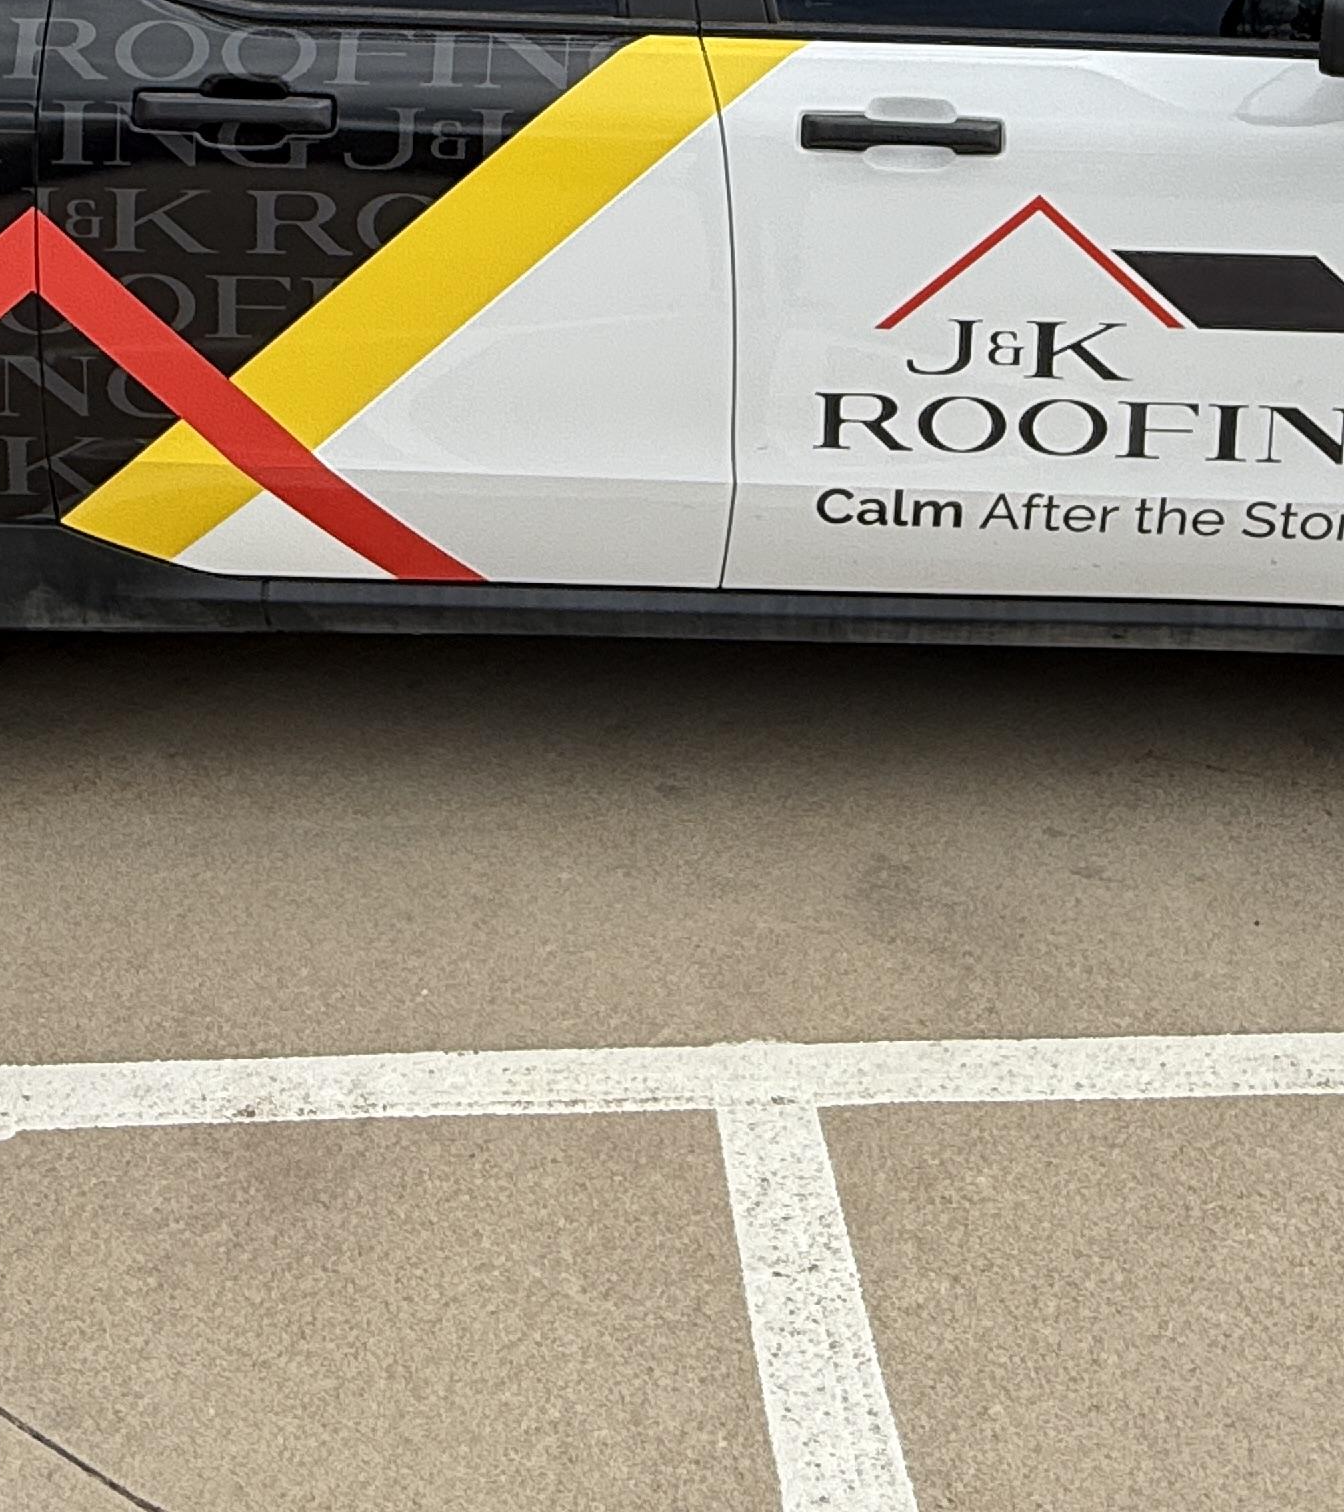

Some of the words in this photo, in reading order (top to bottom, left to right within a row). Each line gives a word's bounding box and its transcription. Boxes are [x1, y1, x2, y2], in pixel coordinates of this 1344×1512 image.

[906, 318, 1134, 382] J&K
[816, 488, 963, 529] Calm
[979, 492, 1120, 534] After
[1136, 494, 1225, 537] the
